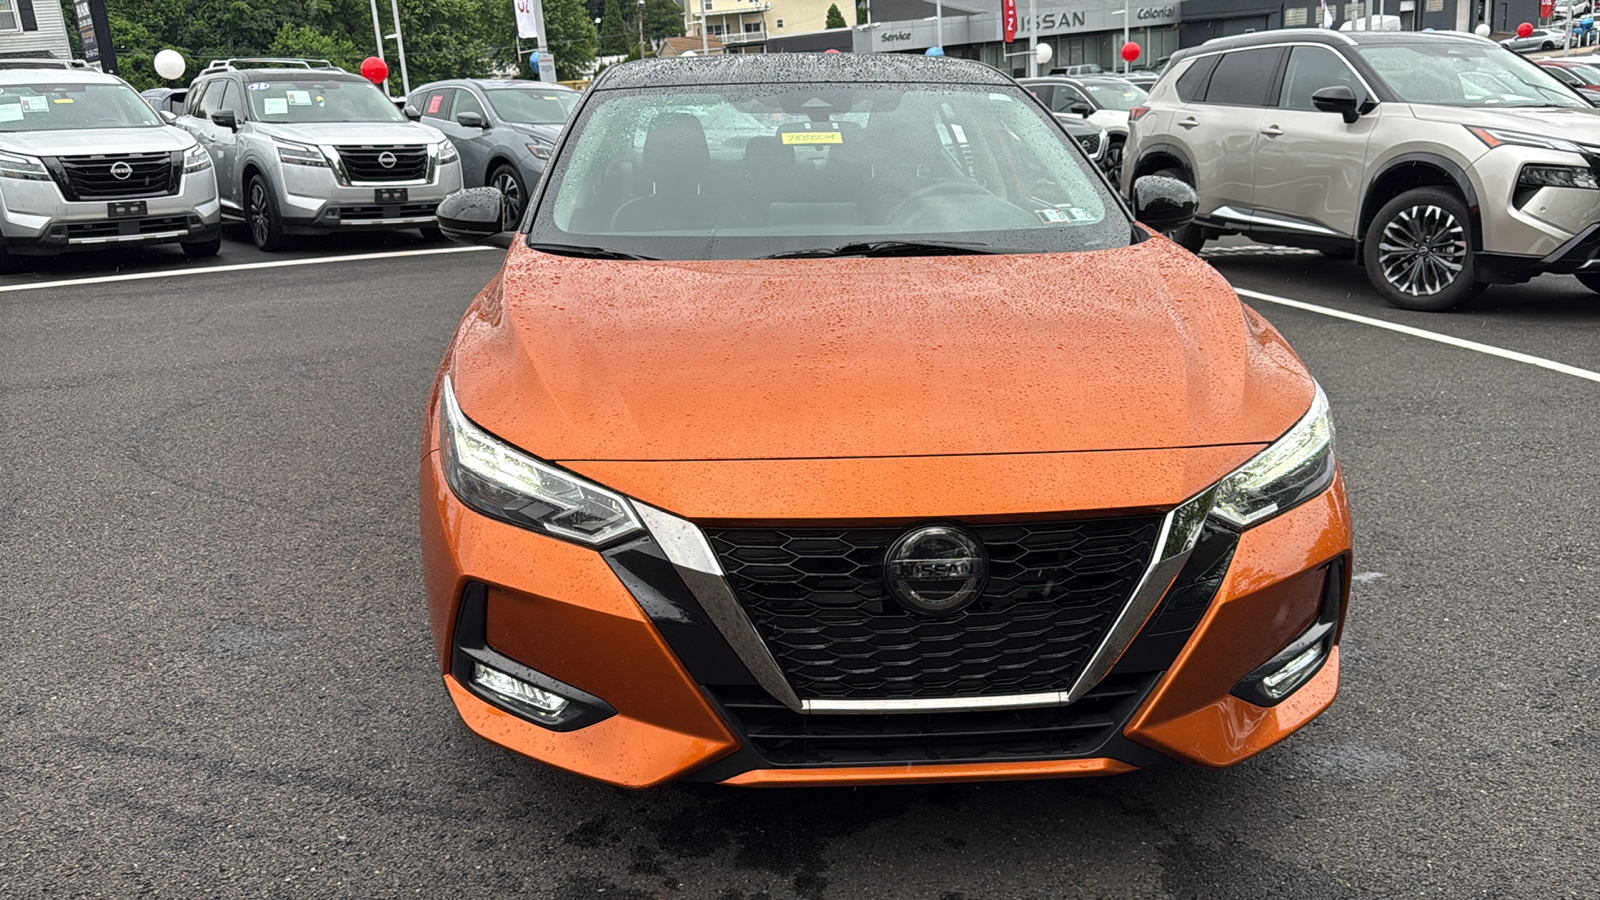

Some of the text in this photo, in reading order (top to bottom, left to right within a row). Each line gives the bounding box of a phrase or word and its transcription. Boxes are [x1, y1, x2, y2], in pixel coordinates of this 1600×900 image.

[1136, 6, 1176, 20] Colonial
[1021, 11, 1086, 32] ISSAN
[881, 30, 912, 42] Service
[900, 561, 975, 578] NISSAN
